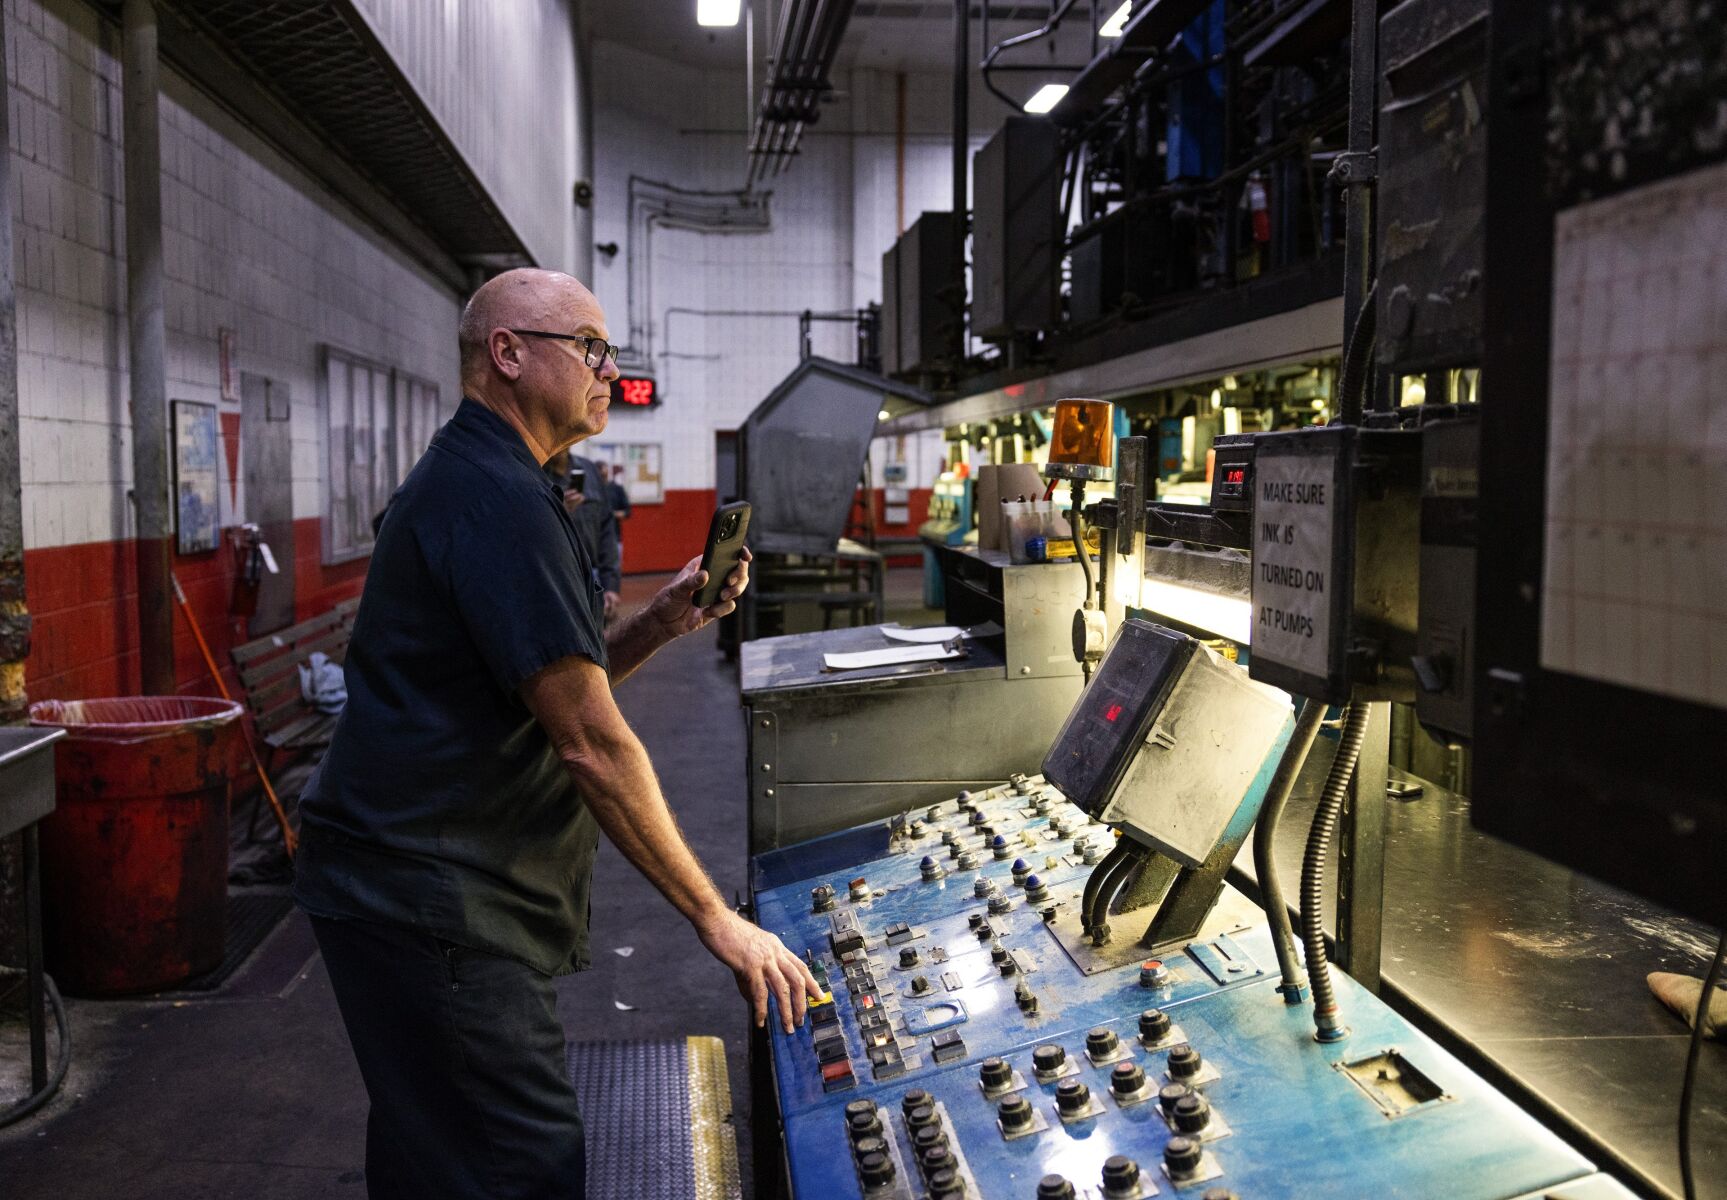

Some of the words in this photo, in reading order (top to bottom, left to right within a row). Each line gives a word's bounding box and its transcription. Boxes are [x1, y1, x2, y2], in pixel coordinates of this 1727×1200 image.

[1263, 482, 1293, 503] MAKE
[1296, 484, 1325, 505] SURE
[1262, 522, 1279, 544] INK
[1284, 525, 1294, 545] IS
[1261, 563, 1303, 588] TURNED
[1305, 571, 1324, 593] ON
[1260, 606, 1274, 627] AT
[1275, 609, 1314, 638] PUMPS
